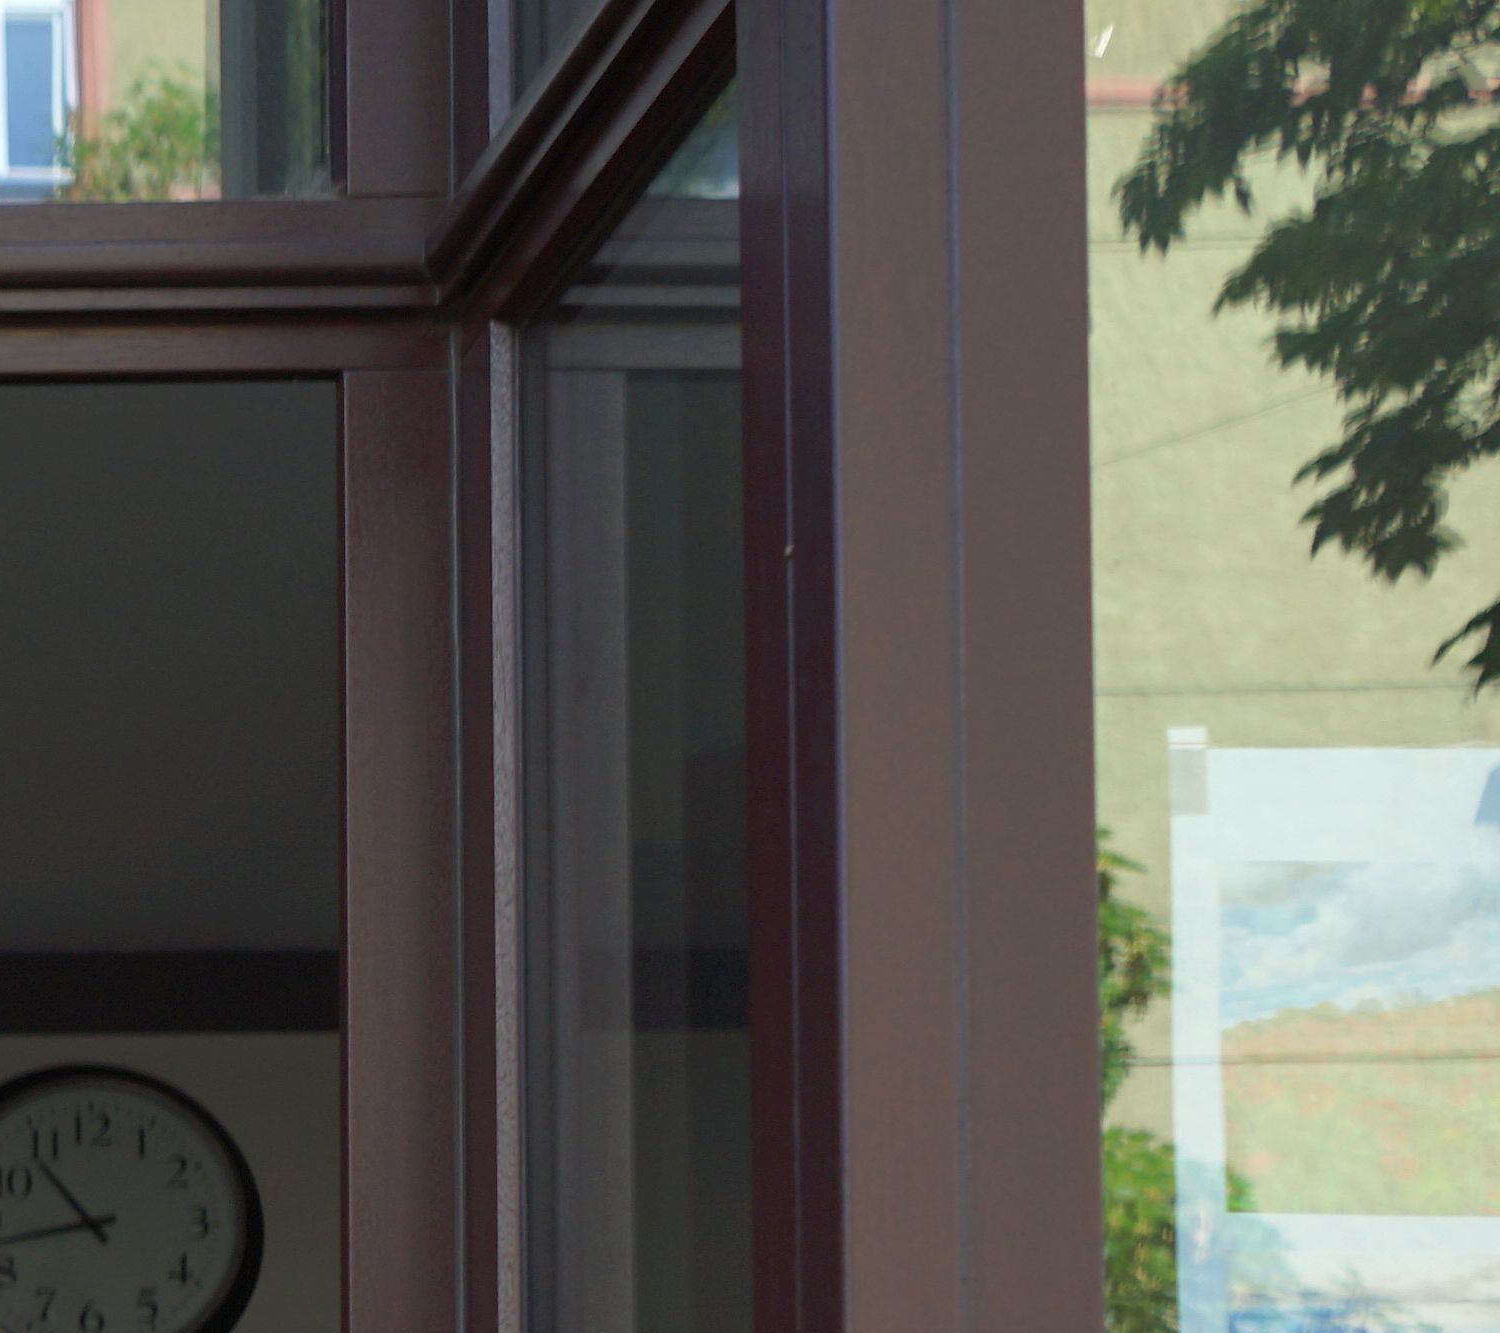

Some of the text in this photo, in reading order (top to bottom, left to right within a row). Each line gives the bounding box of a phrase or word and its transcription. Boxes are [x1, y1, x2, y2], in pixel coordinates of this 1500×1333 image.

[32, 1129, 59, 1161] 11
[75, 1114, 112, 1147] 12
[167, 1153, 189, 1190] 2
[35, 1286, 56, 1322] 7
